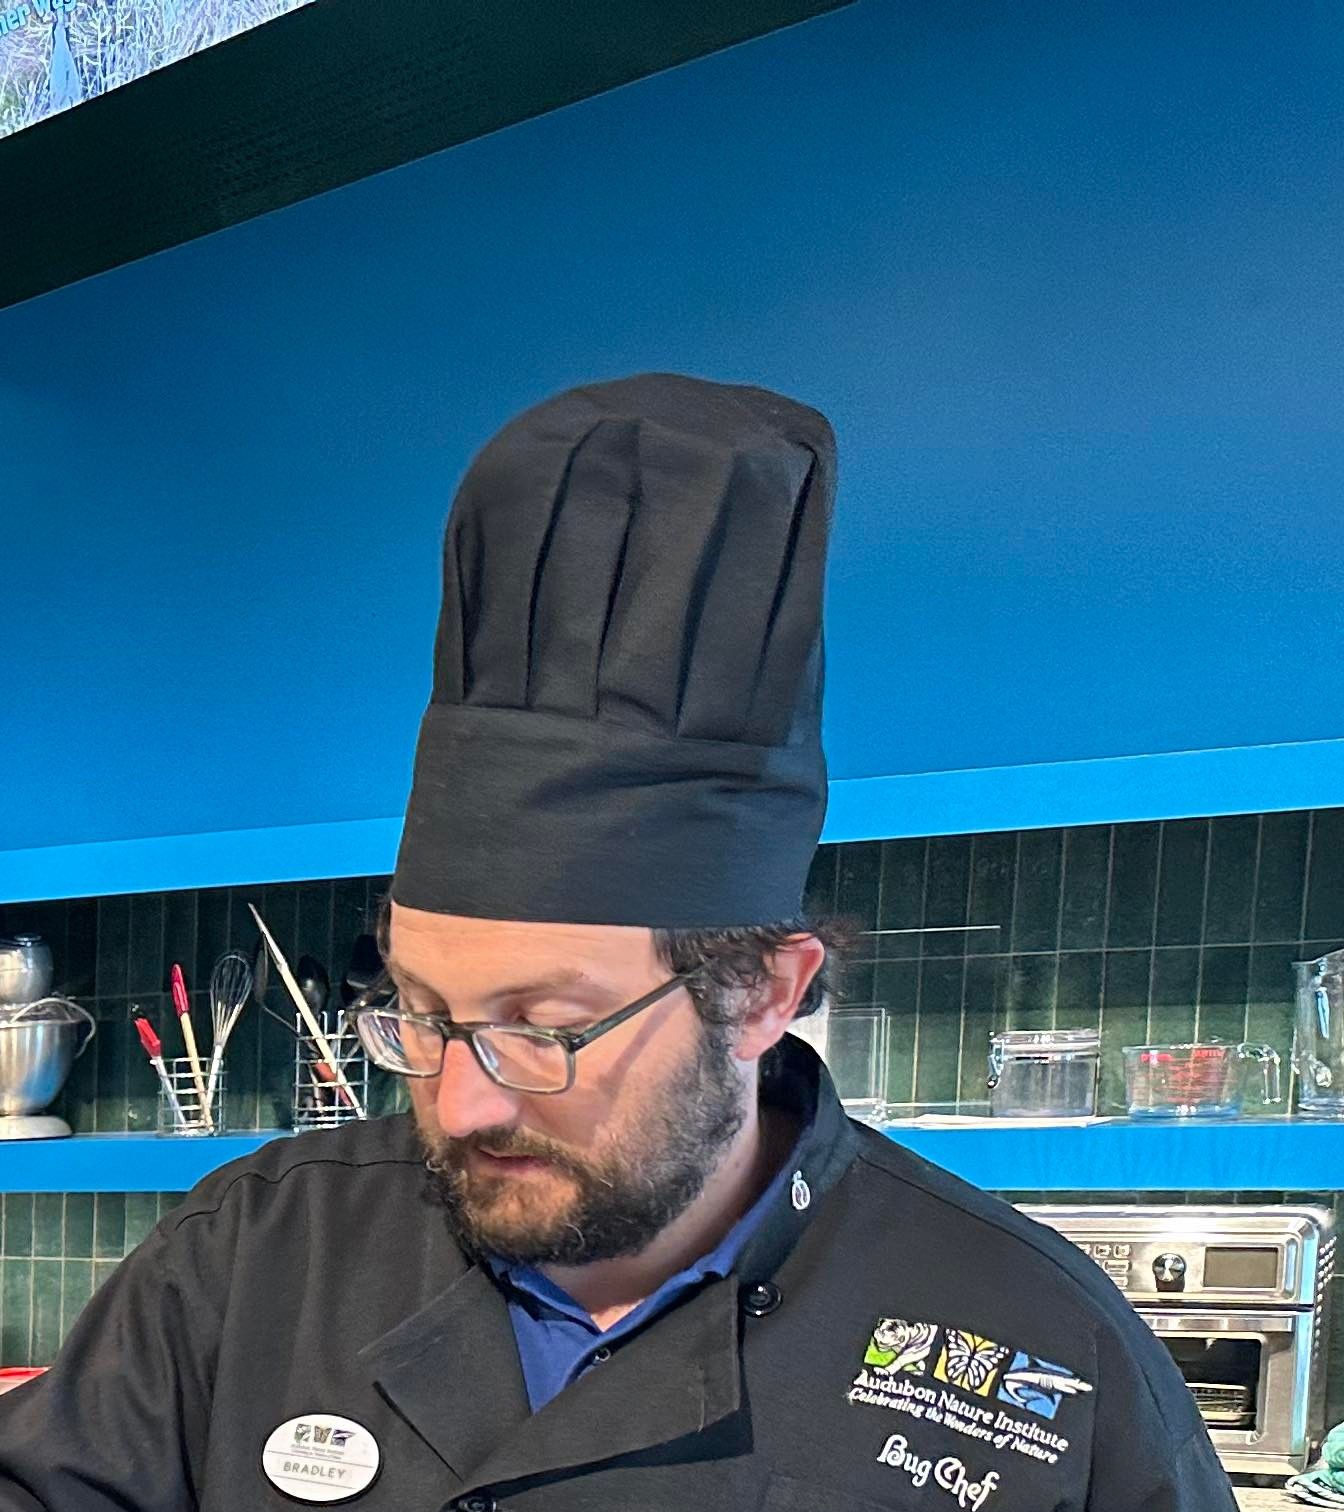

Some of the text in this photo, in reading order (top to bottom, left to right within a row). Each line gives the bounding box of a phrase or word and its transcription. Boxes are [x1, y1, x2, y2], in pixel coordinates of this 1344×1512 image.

[849, 1388, 1058, 1464] Celebrating the Wonders of Nature
[853, 1369, 1069, 1452] Audubon Nature Institute
[282, 1461, 347, 1480] BRADLEY
[876, 1434, 1000, 1512] Bug Chef
